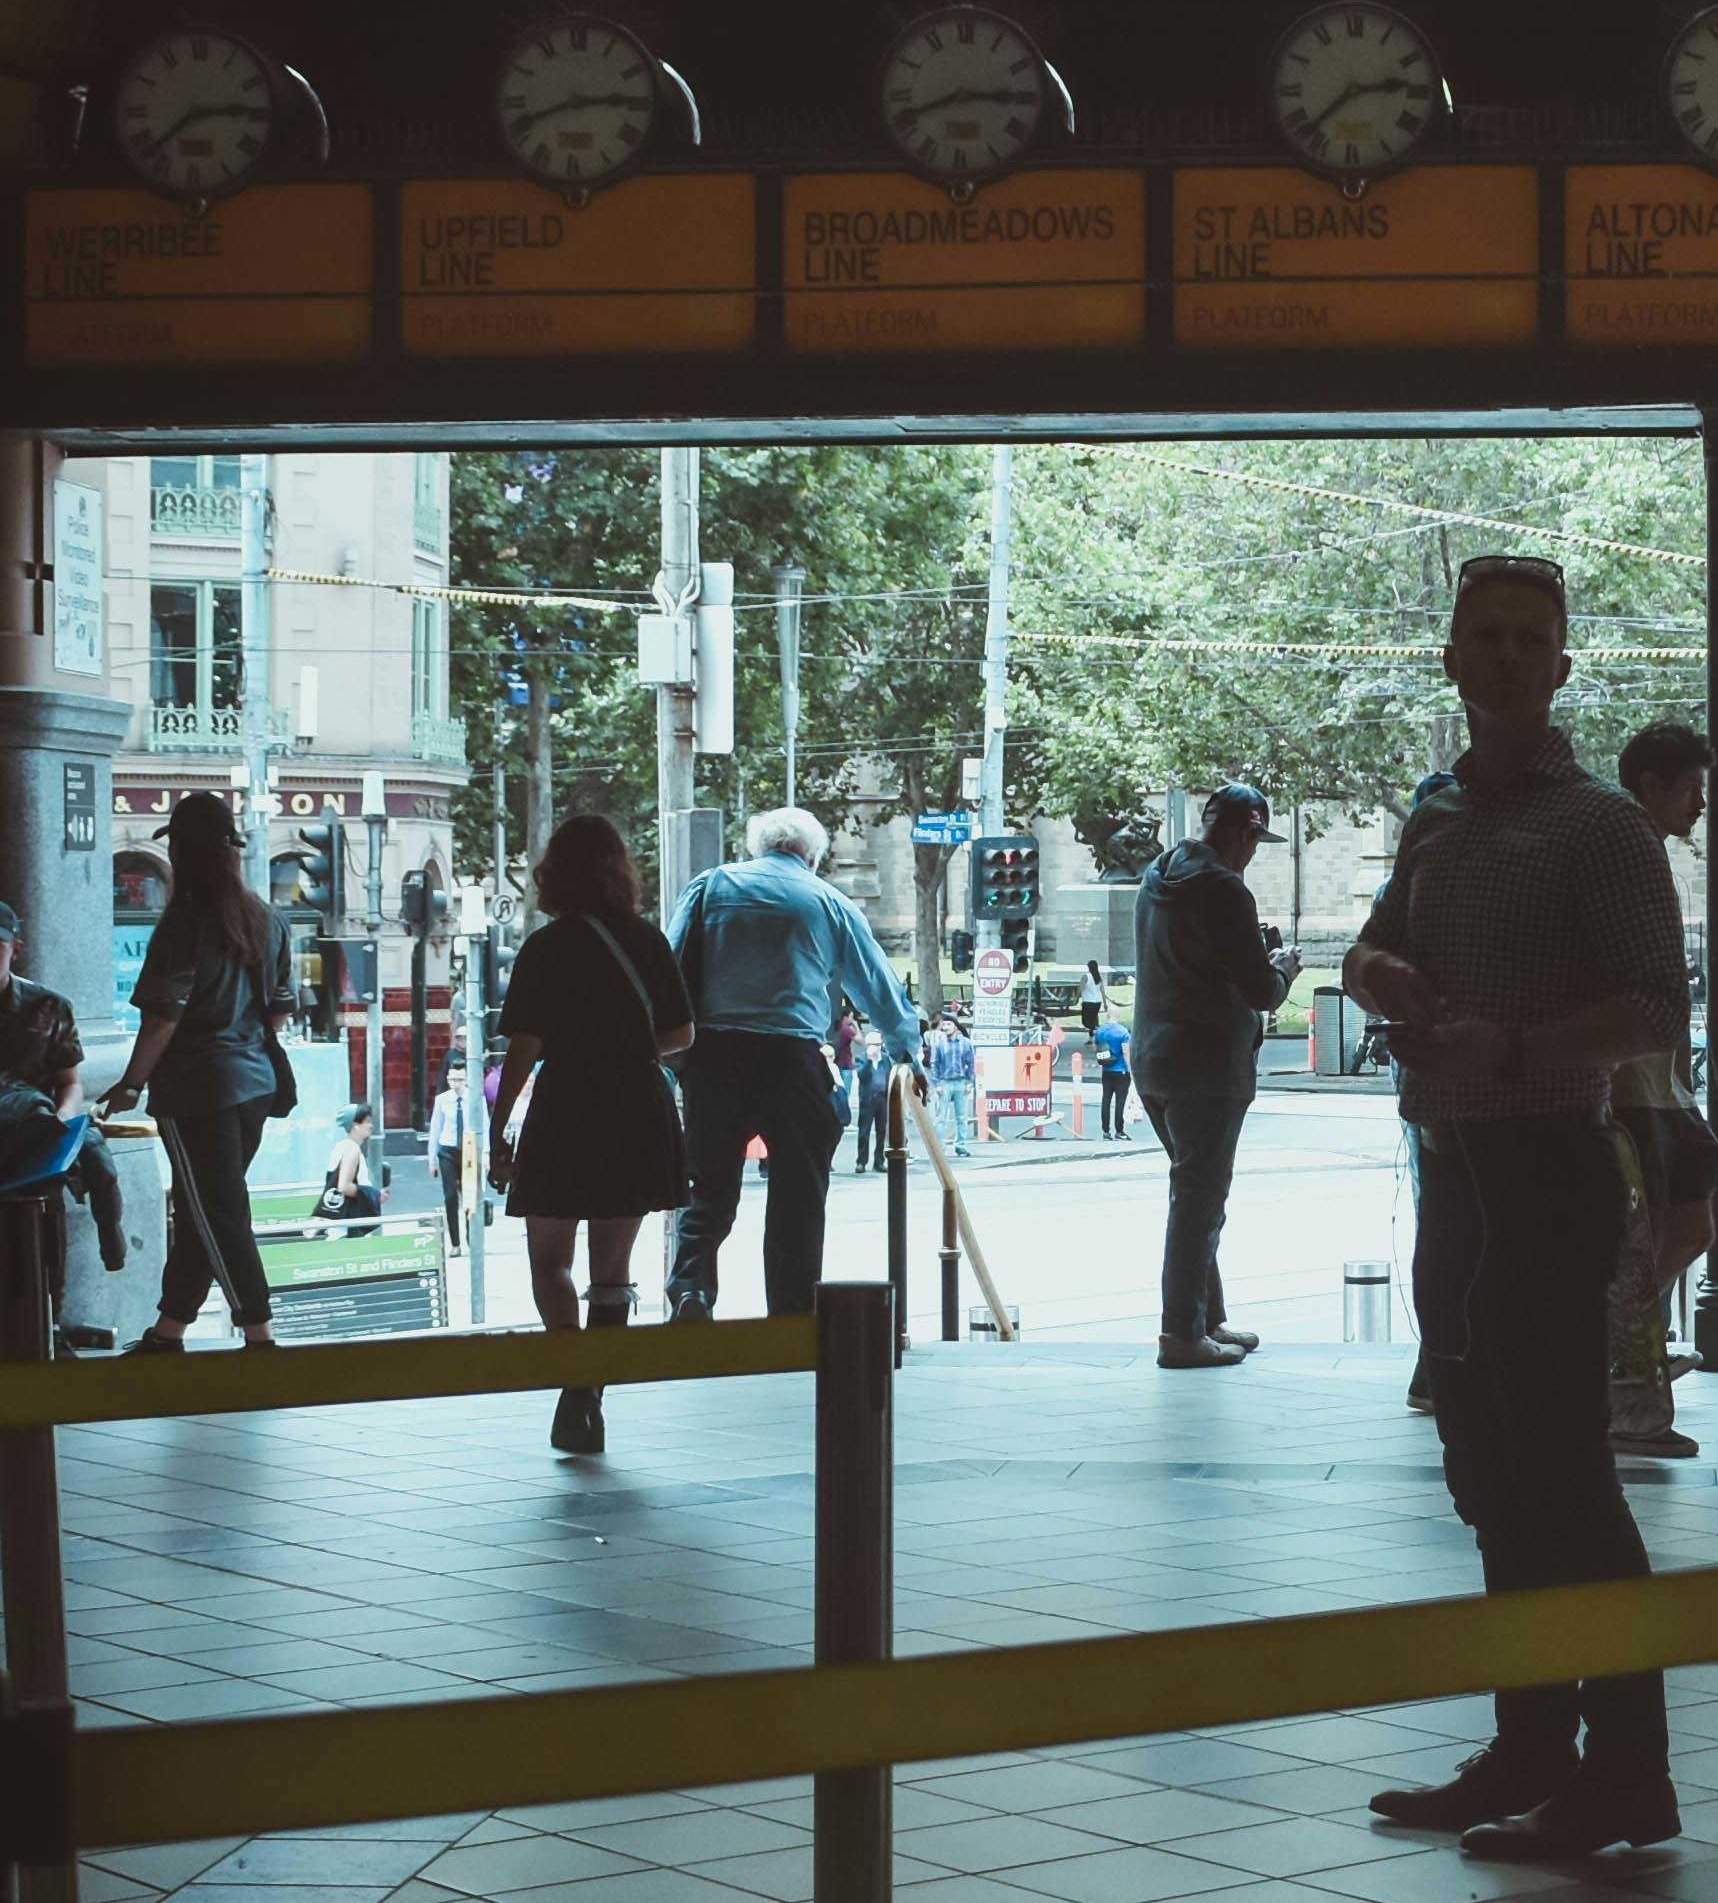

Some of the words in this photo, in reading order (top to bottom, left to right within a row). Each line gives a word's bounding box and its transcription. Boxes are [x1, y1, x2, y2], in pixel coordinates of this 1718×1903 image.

[419, 214, 564, 250] UPFIELD
[804, 205, 1115, 246] BROADMEADOWS
[1194, 205, 1239, 240] ST
[1249, 204, 1390, 240] ALBANS
[46, 222, 224, 258] WERRIBEE
[419, 251, 498, 287] LINE
[804, 248, 881, 283] LINE
[1193, 243, 1273, 278] LINE
[1585, 241, 1664, 276] LINE
[43, 261, 120, 296] LINE
[421, 312, 553, 340] PLATFORM
[803, 309, 938, 334] PLATFORM
[1192, 305, 1329, 331] PLATFORM
[114, 795, 133, 813] &
[988, 957, 1000, 967] NO
[979, 978, 1006, 988] ENTRY
[1015, 1098, 1024, 1111] TO
[1027, 1097, 1046, 1111] STOP
[345, 1262, 358, 1275] St
[360, 1261, 379, 1272] and
[382, 1257, 422, 1270] Flinders
[424, 1254, 436, 1265] St
